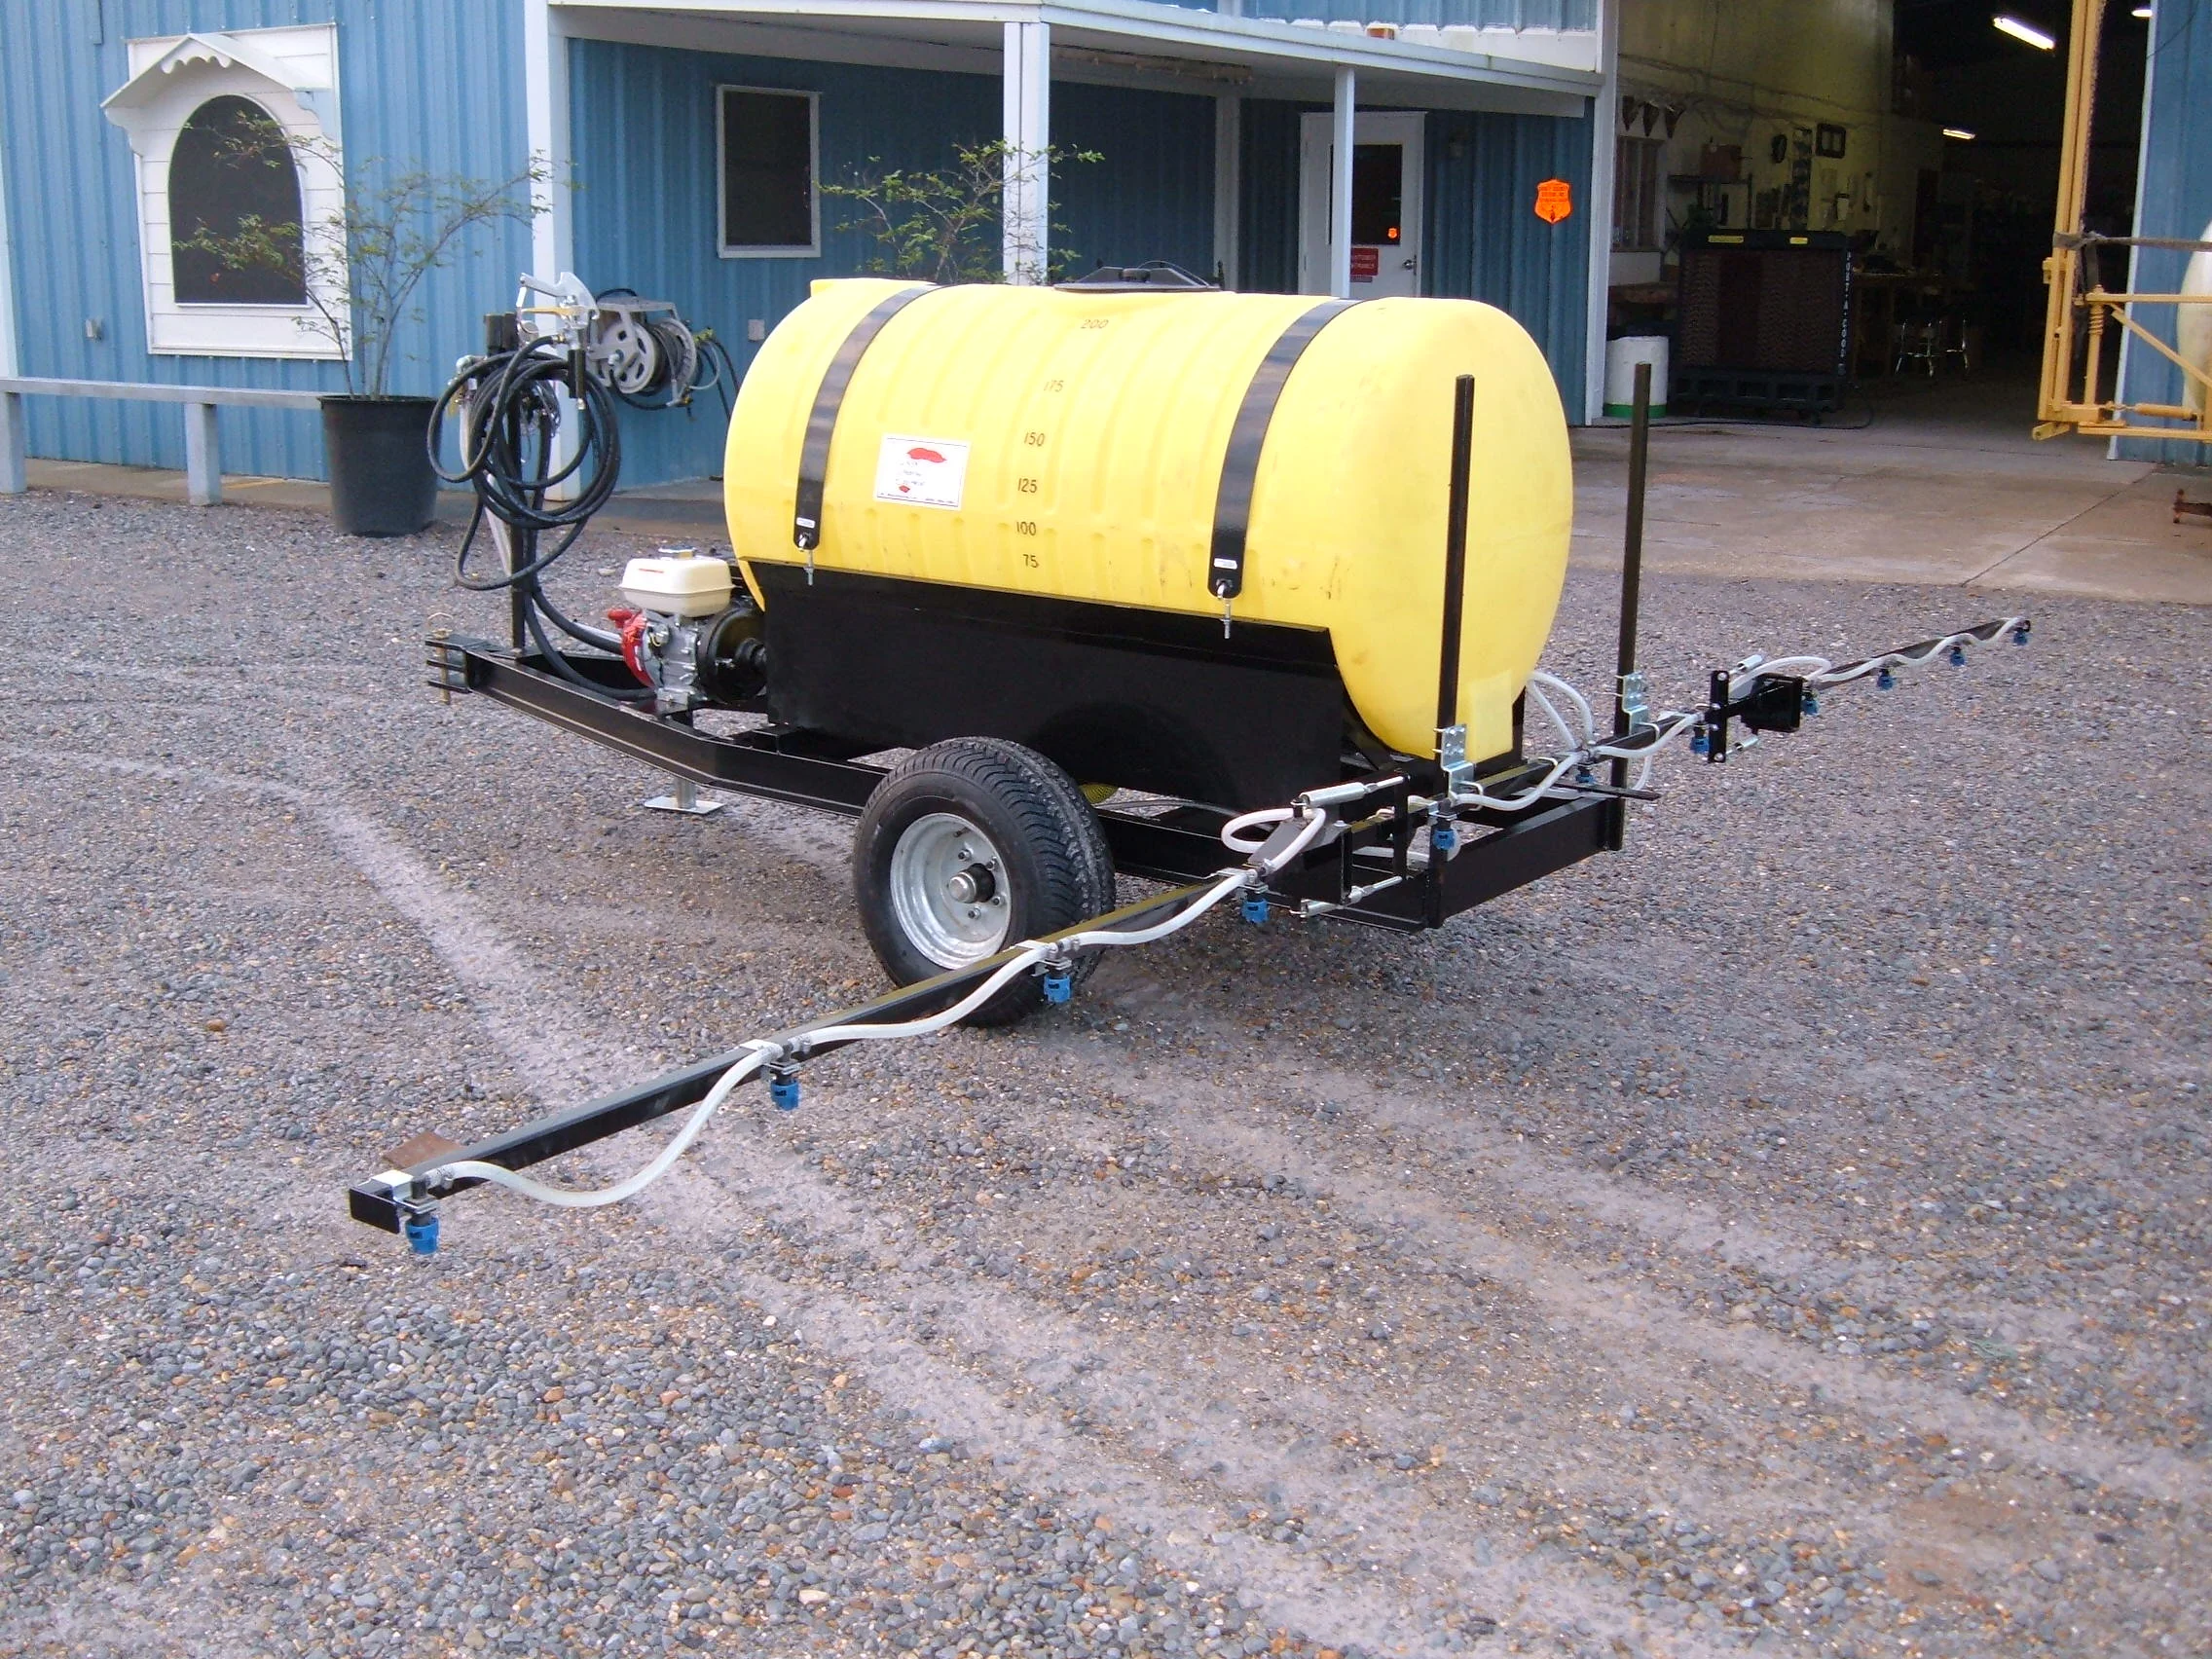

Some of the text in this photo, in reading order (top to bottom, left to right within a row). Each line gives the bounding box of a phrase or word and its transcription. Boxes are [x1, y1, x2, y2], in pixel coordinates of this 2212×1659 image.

[1080, 318, 1109, 329] 200
[1043, 379, 1064, 392] 175
[1023, 431, 1046, 447] 150
[1017, 477, 1038, 494] 125
[1015, 521, 1037, 536] 100
[1022, 553, 1039, 568] 75
